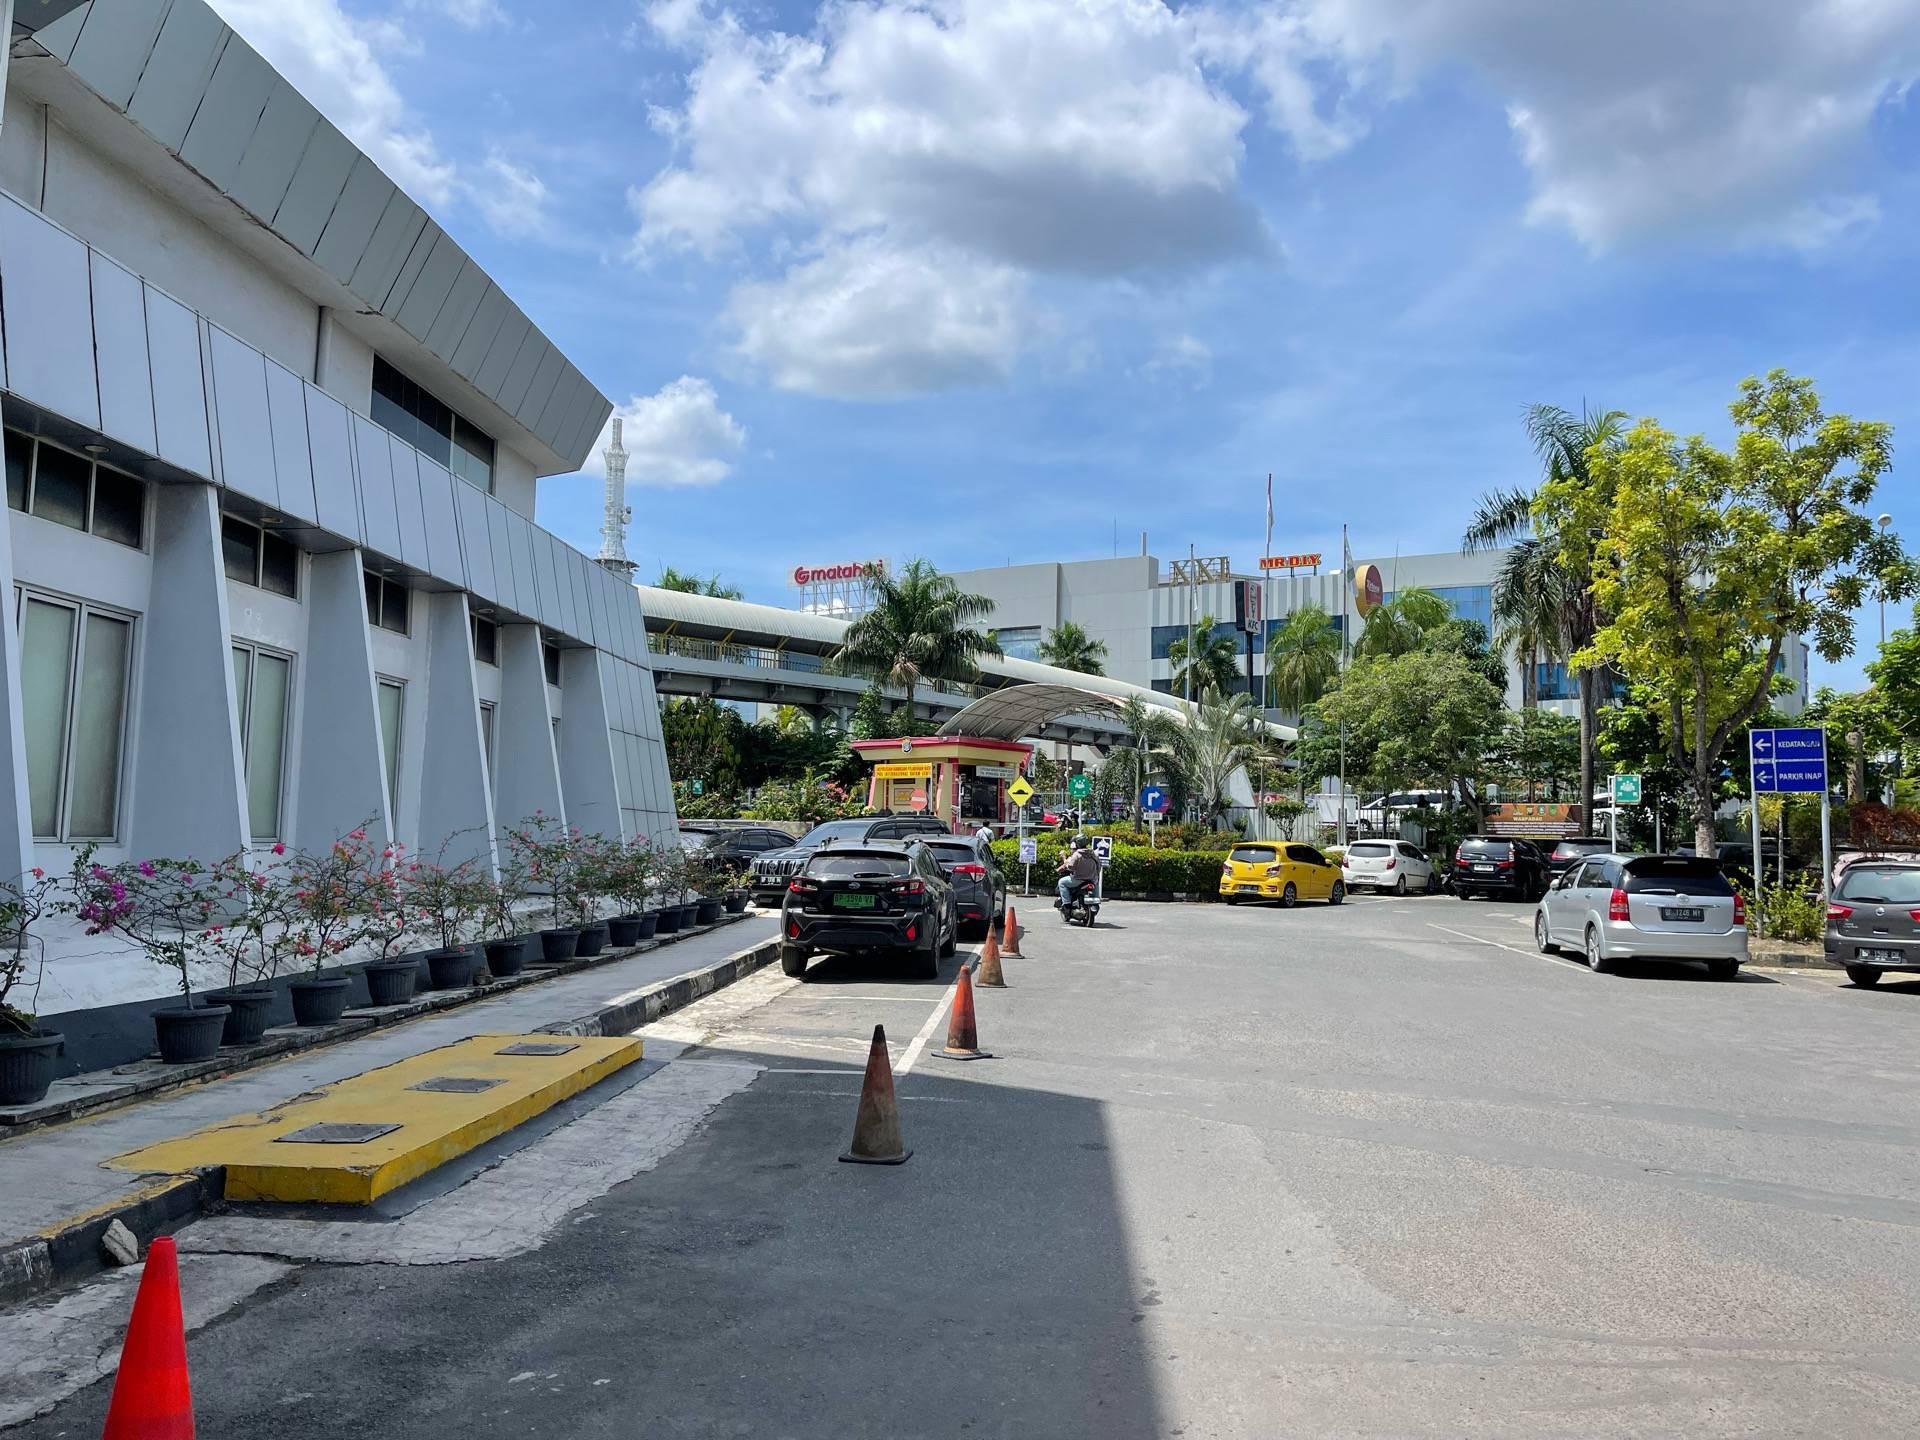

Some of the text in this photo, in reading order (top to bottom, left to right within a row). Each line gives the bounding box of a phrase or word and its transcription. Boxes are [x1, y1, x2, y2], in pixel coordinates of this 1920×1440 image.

[811, 559, 883, 581] matahi
[1170, 556, 1230, 586] XXI
[1779, 772, 1822, 780] PARKIR INAP
